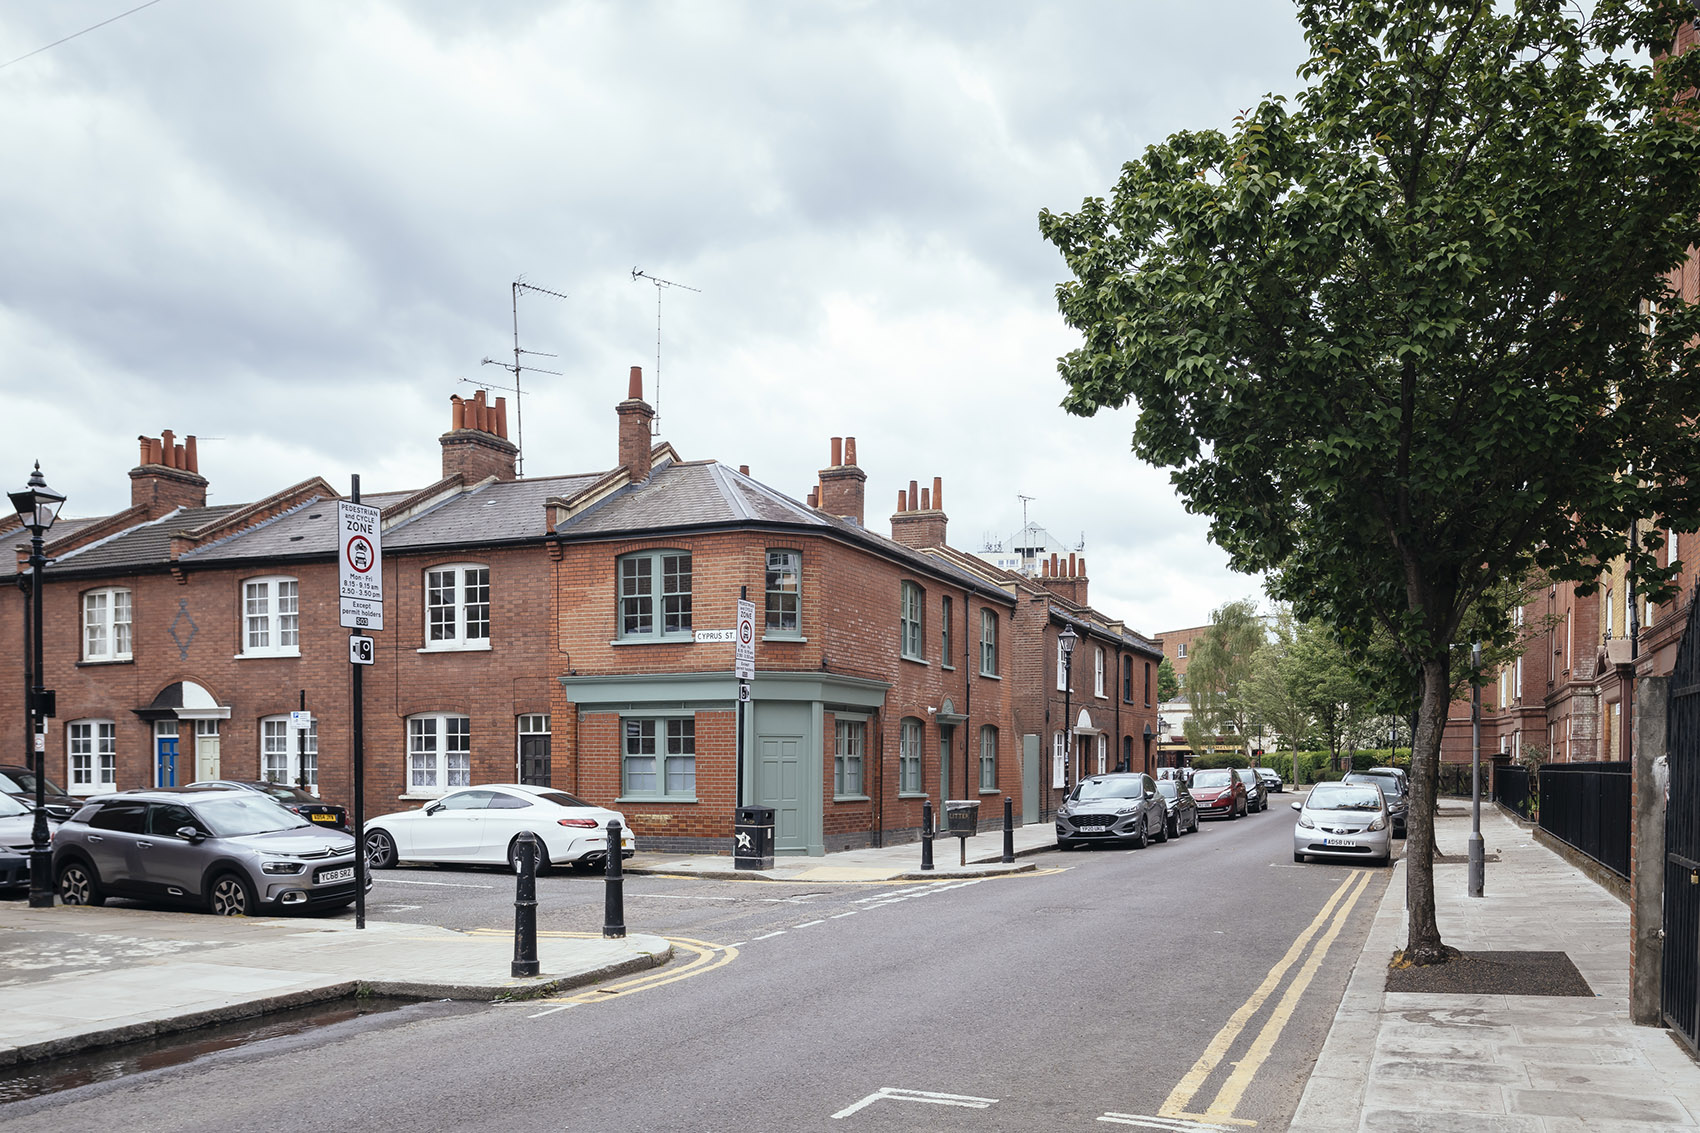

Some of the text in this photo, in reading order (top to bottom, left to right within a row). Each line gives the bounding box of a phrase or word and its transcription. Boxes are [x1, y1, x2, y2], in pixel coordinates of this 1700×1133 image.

[341, 503, 378, 517] PEDESTRIAN
[356, 514, 375, 524] CYCLE
[346, 520, 373, 534] ZONE
[343, 579, 355, 587] 8.15
[359, 581, 370, 589] 9.15
[342, 587, 355, 595] 2.50
[352, 601, 371, 609] Except
[361, 609, 381, 618] holders
[740, 610, 752, 620] ZONE
[697, 631, 735, 640] CYPRUS ST.
[321, 868, 352, 880] YC68 SRZ
